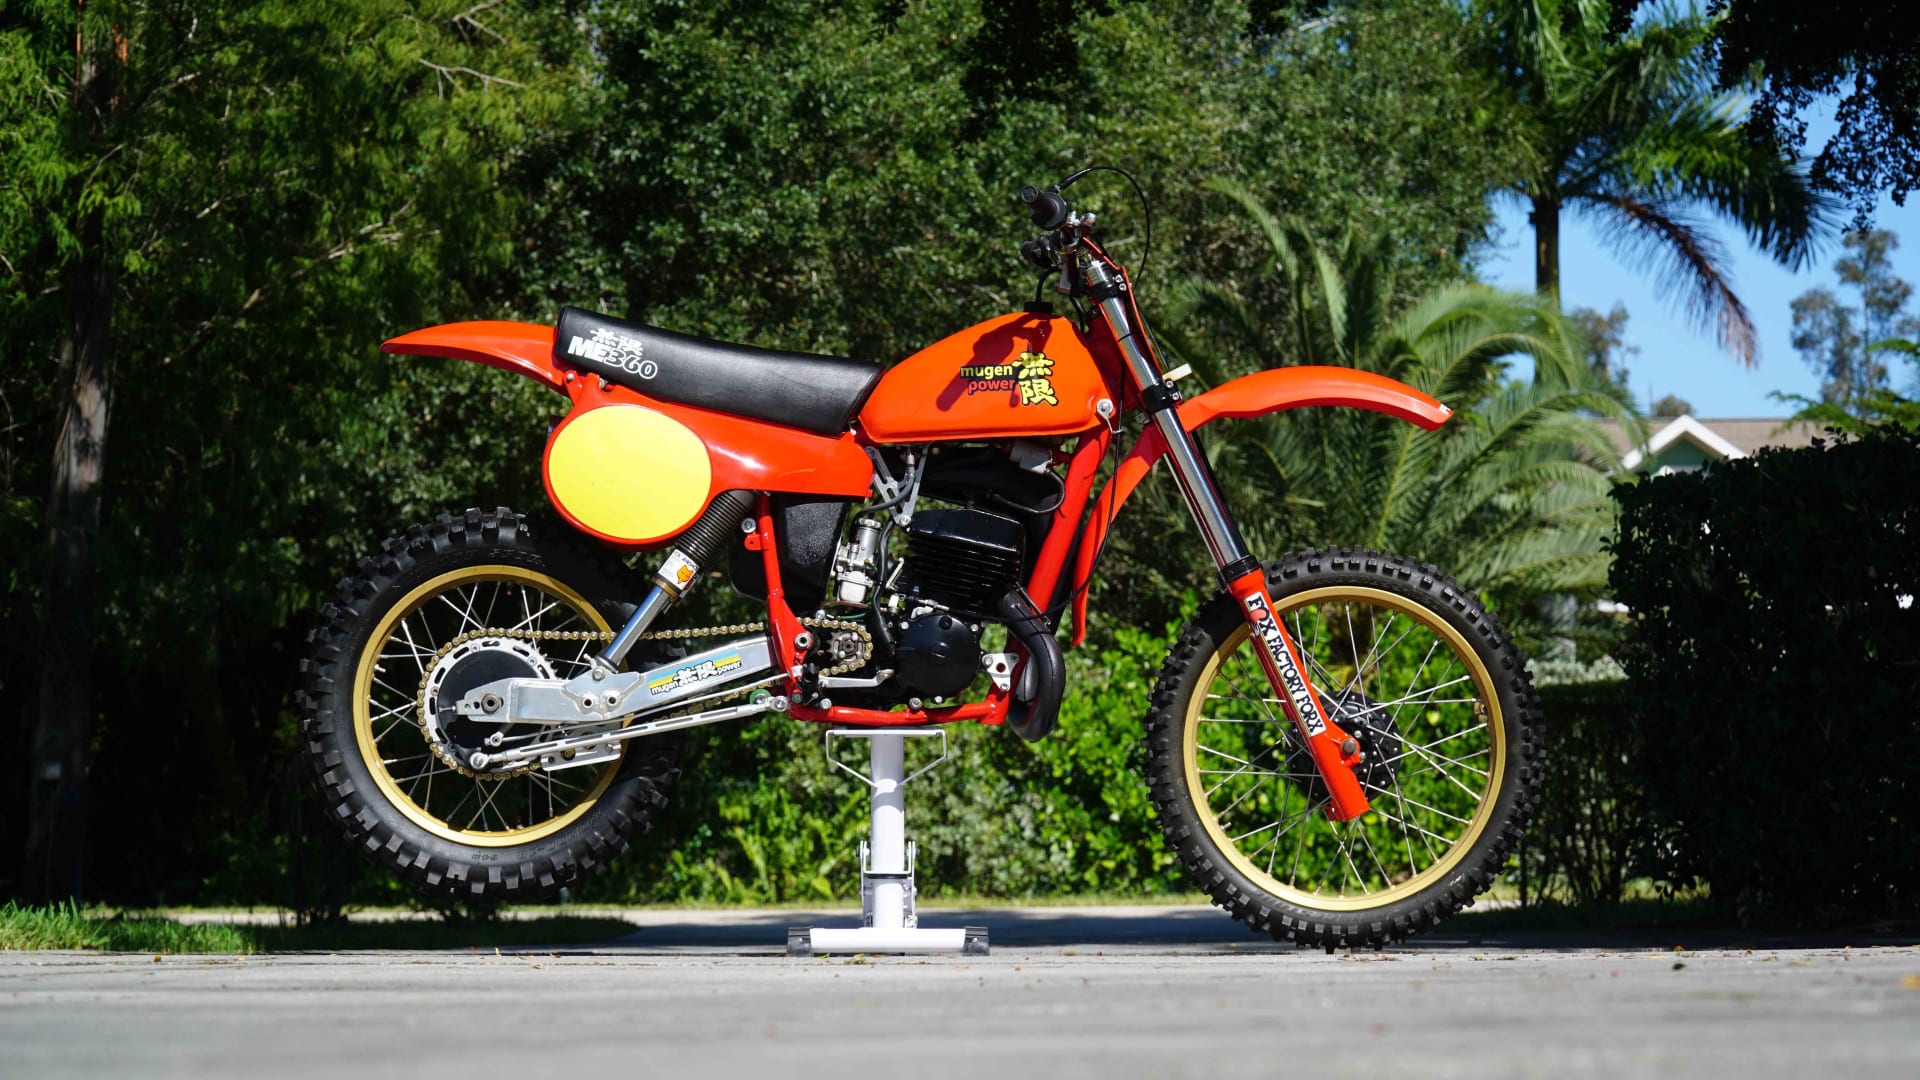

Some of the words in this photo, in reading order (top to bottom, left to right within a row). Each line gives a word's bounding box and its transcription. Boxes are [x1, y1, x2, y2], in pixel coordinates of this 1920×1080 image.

[960, 365, 1013, 380] mugen
[968, 379, 1015, 394] power
[1248, 596, 1277, 636] FOX
[1267, 636, 1306, 693] FACTORY
[1297, 694, 1323, 732] FORX
[651, 681, 679, 695] mugen
[717, 661, 742, 676] power
